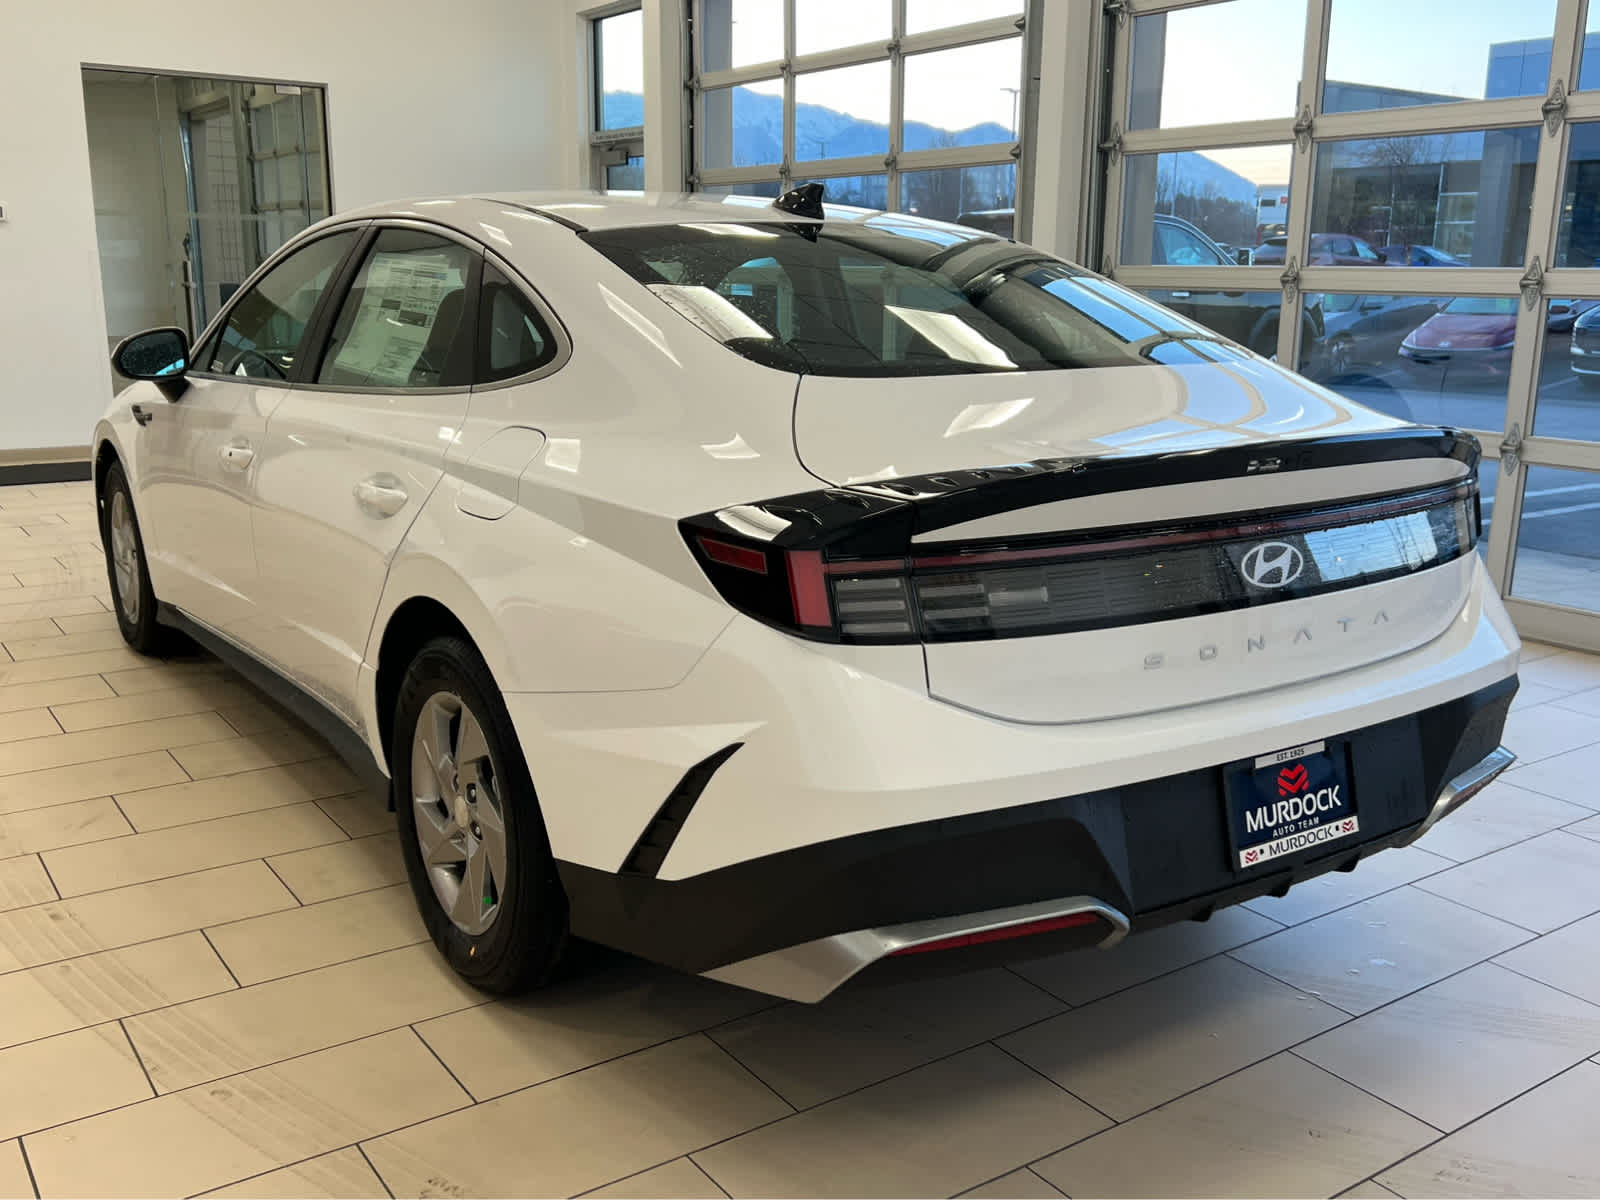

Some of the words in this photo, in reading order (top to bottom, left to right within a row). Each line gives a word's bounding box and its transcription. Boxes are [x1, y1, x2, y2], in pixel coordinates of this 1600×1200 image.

[1143, 608, 1390, 670] SONATA
[1245, 785, 1342, 833] MURDOCK
[1272, 823, 1295, 838] AUTO
[1298, 816, 1320, 829] TEAM
[1269, 826, 1333, 856] MURDOCK
